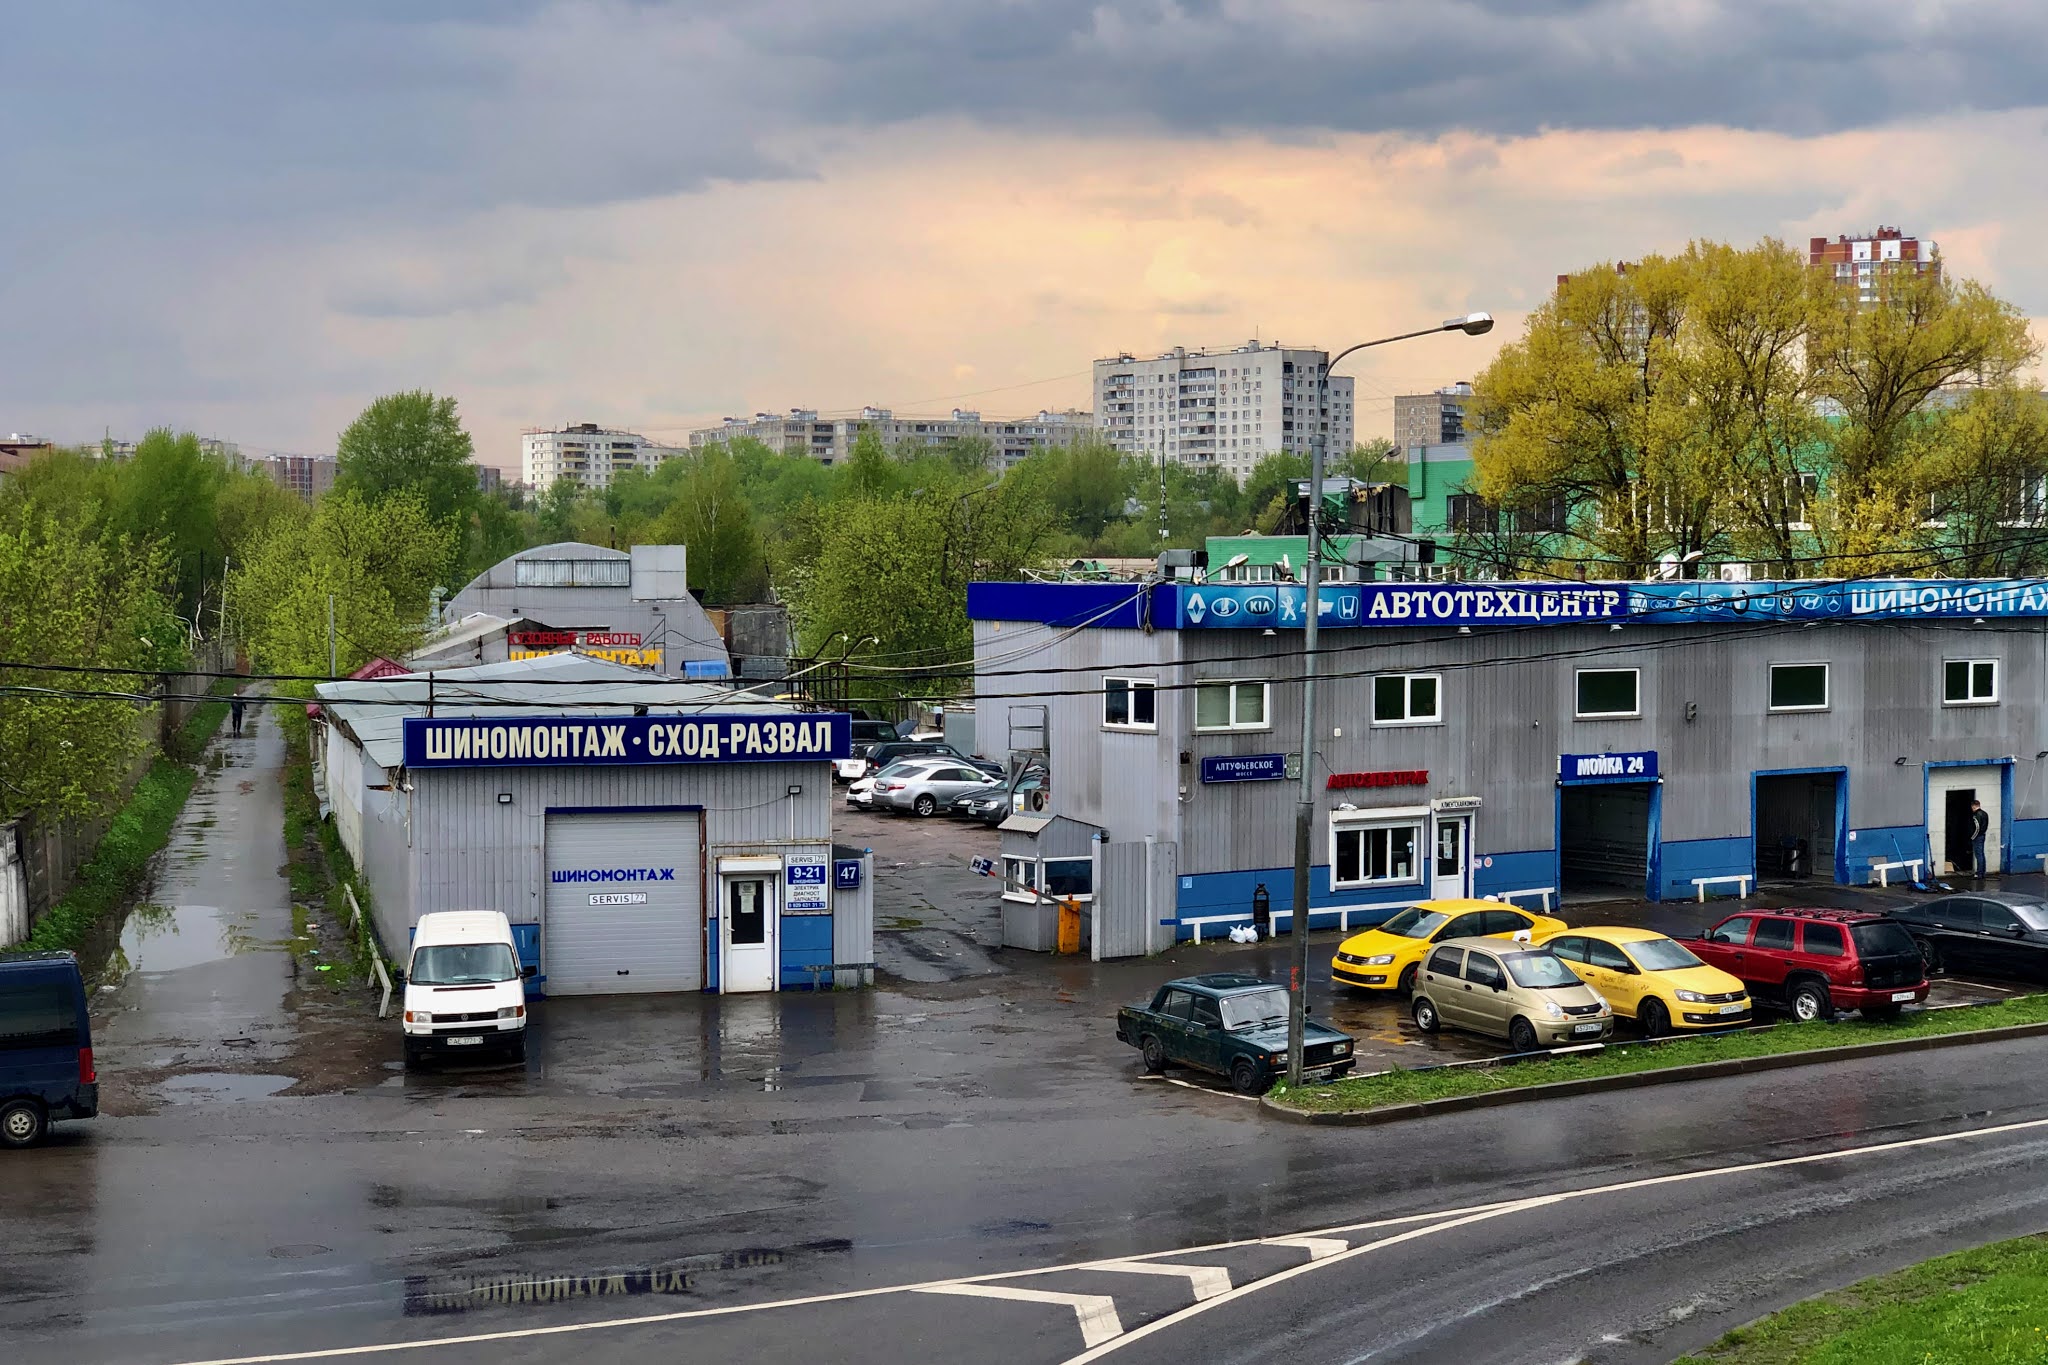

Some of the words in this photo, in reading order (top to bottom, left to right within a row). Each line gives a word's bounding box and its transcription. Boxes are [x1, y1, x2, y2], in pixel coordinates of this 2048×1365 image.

[1250, 601, 1270, 613] KIA
[1368, 590, 1620, 621] АВТОТЕХЦЕНТР
[586, 632, 641, 646] РАБОТЫ
[425, 724, 627, 760] ШИНОМОНТАЖ
[648, 721, 832, 758] СХОД-РАЗВАЛ
[1215, 760, 1274, 771] АЛТУФЬЕВСКОЕ
[1577, 755, 1624, 776] МОЙКА
[1627, 756, 1644, 774] 24
[552, 868, 675, 883] ШИНОМОНТАЖ
[794, 866, 820, 878] 9-21
[840, 866, 857, 880] 47
[592, 895, 630, 904] SERVIS
[635, 893, 644, 901] 77
